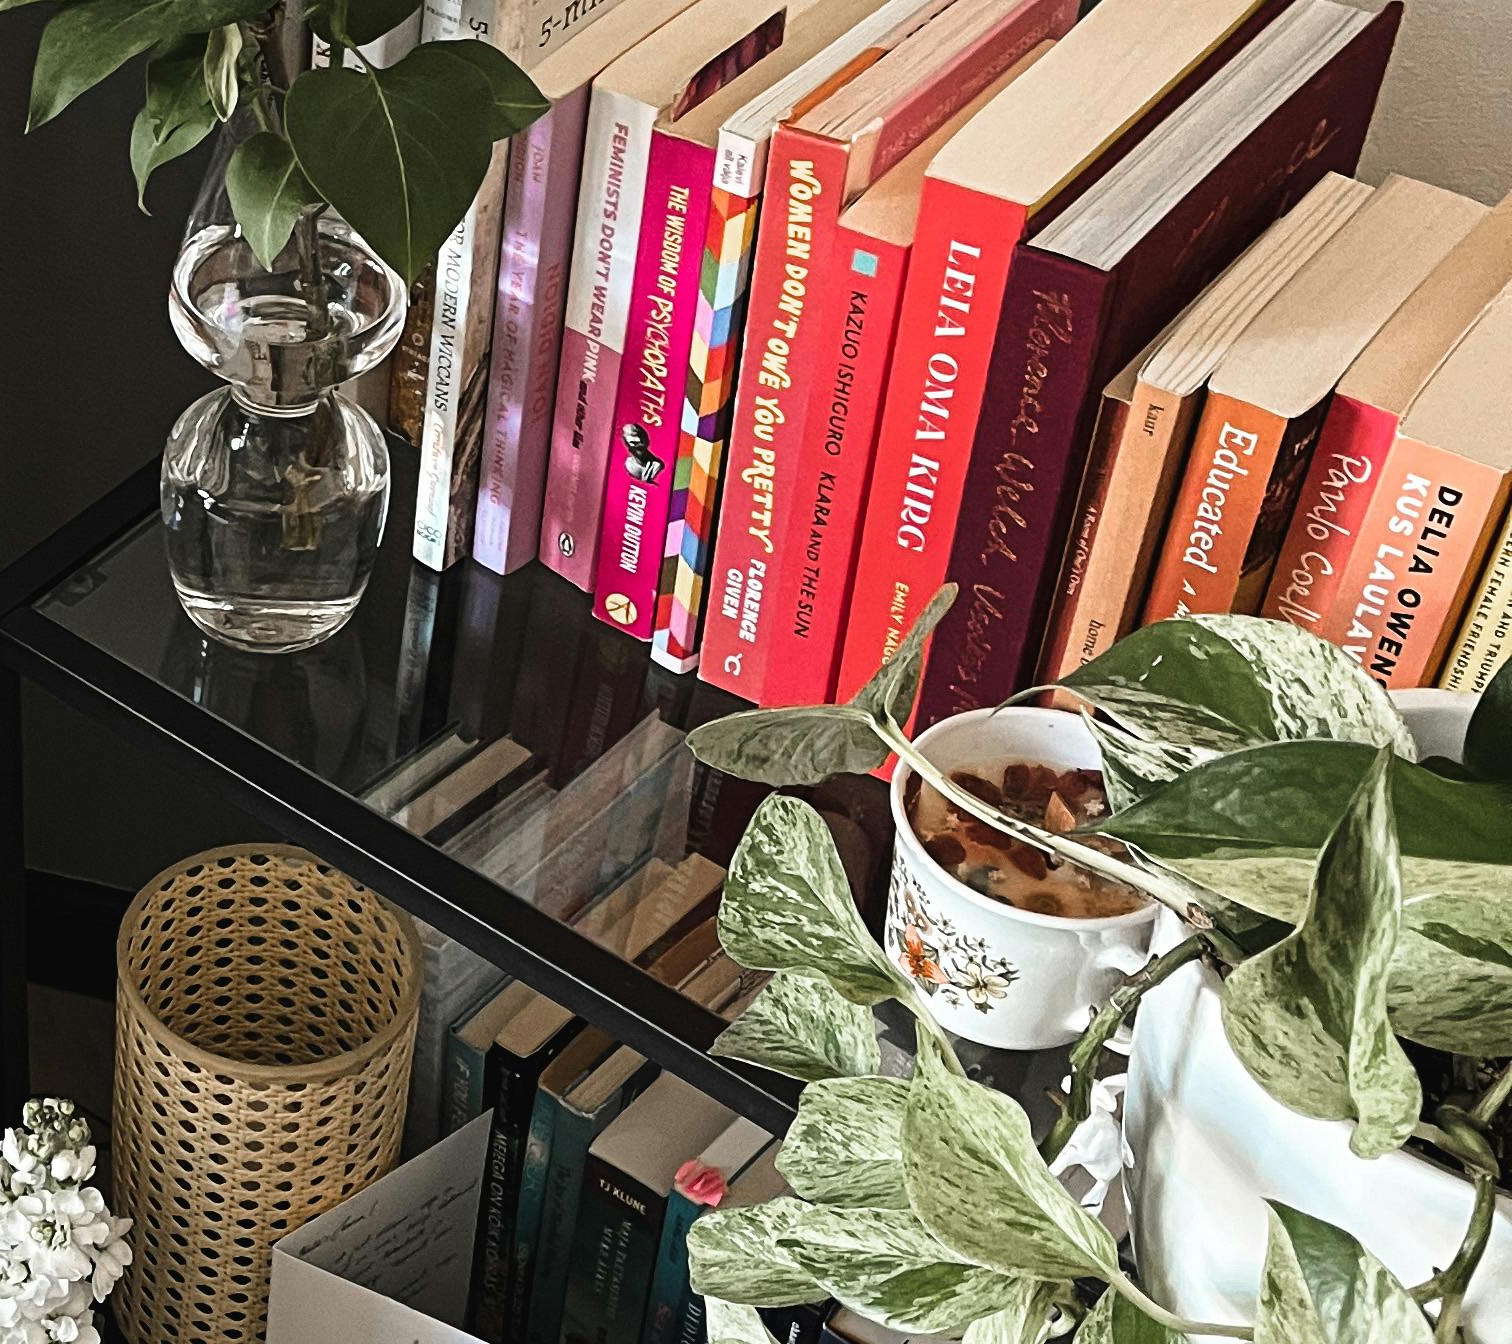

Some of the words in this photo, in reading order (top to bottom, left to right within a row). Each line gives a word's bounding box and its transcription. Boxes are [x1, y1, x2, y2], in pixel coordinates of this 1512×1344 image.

[603, 121, 629, 223] FEMINISTS
[669, 184, 689, 216] THE
[788, 159, 822, 258] WOMEN
[595, 227, 616, 282] DON'T
[664, 215, 686, 275] WISDOM
[442, 250, 464, 329] MODERN
[508, 270, 525, 320] YEAR
[587, 286, 608, 340] WEAR
[660, 276, 677, 297] OF
[779, 262, 807, 339] DON'T
[933, 239, 982, 338] LEIA
[506, 323, 519, 348] OF
[842, 290, 866, 359] KAZUO
[435, 333, 455, 413] WICCANS
[496, 351, 515, 423] MAGICAL
[581, 338, 601, 384] PINK
[638, 293, 675, 428] PSYCHOPATHS
[759, 337, 791, 388] OWE
[755, 392, 784, 440] YOU
[824, 361, 855, 456] ISHIGURO
[914, 353, 961, 442] OMA
[1142, 403, 1165, 437] kaur
[489, 427, 507, 505] THINKING
[627, 485, 647, 528] KEVIN
[742, 437, 776, 554] PRETTY
[815, 472, 836, 527] KLARA
[896, 457, 940, 553] KIRG
[1183, 422, 1259, 574] Educated
[1306, 453, 1372, 541] Paulo
[1388, 472, 1433, 537] KUS
[619, 528, 641, 575] DUTTON
[807, 529, 825, 560] AND
[1408, 485, 1463, 574] DELIA
[722, 567, 740, 617] GIVEN
[740, 558, 766, 641] FLORENCE
[802, 562, 820, 600] THE
[891, 581, 911, 625] EMILY
[1182, 579, 1197, 597] A
[1340, 543, 1404, 663] LAULAV
[1476, 570, 1505, 621] FEMALE
[794, 603, 814, 639] SUN
[881, 628, 902, 666] NAGO
[1085, 619, 1105, 654] home
[1446, 622, 1484, 692] FRIENDSHI
[1471, 642, 1501, 694] TRIUMP
[599, 1178, 612, 1193] TJ
[612, 1187, 647, 1216] KLUNE
